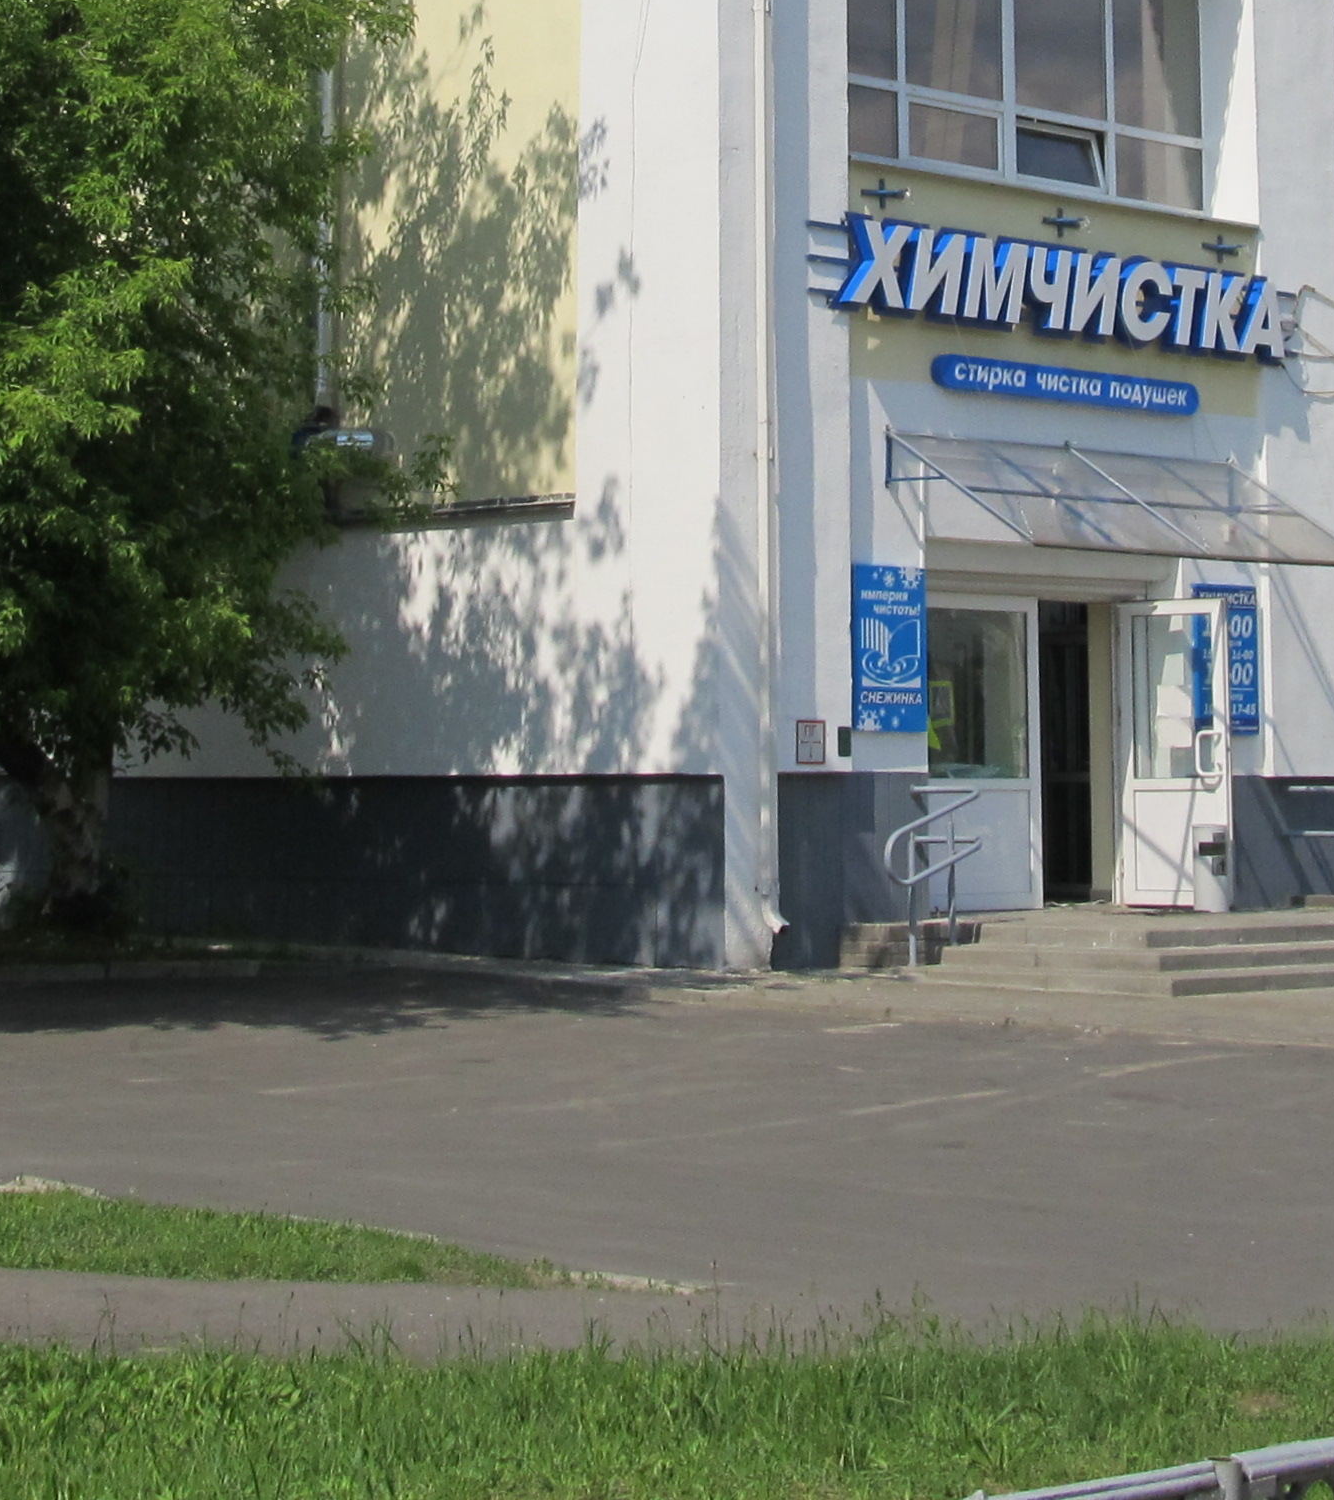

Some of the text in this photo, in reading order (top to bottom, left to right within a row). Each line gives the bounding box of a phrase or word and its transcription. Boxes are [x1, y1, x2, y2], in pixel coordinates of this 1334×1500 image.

[842, 216, 1286, 360] ХИМЧИСТКА
[953, 362, 1189, 409] стирка чистка подушек
[860, 588, 909, 604] империя
[873, 603, 922, 616] чистоты!
[860, 691, 923, 704] СНЕЖИНКА
